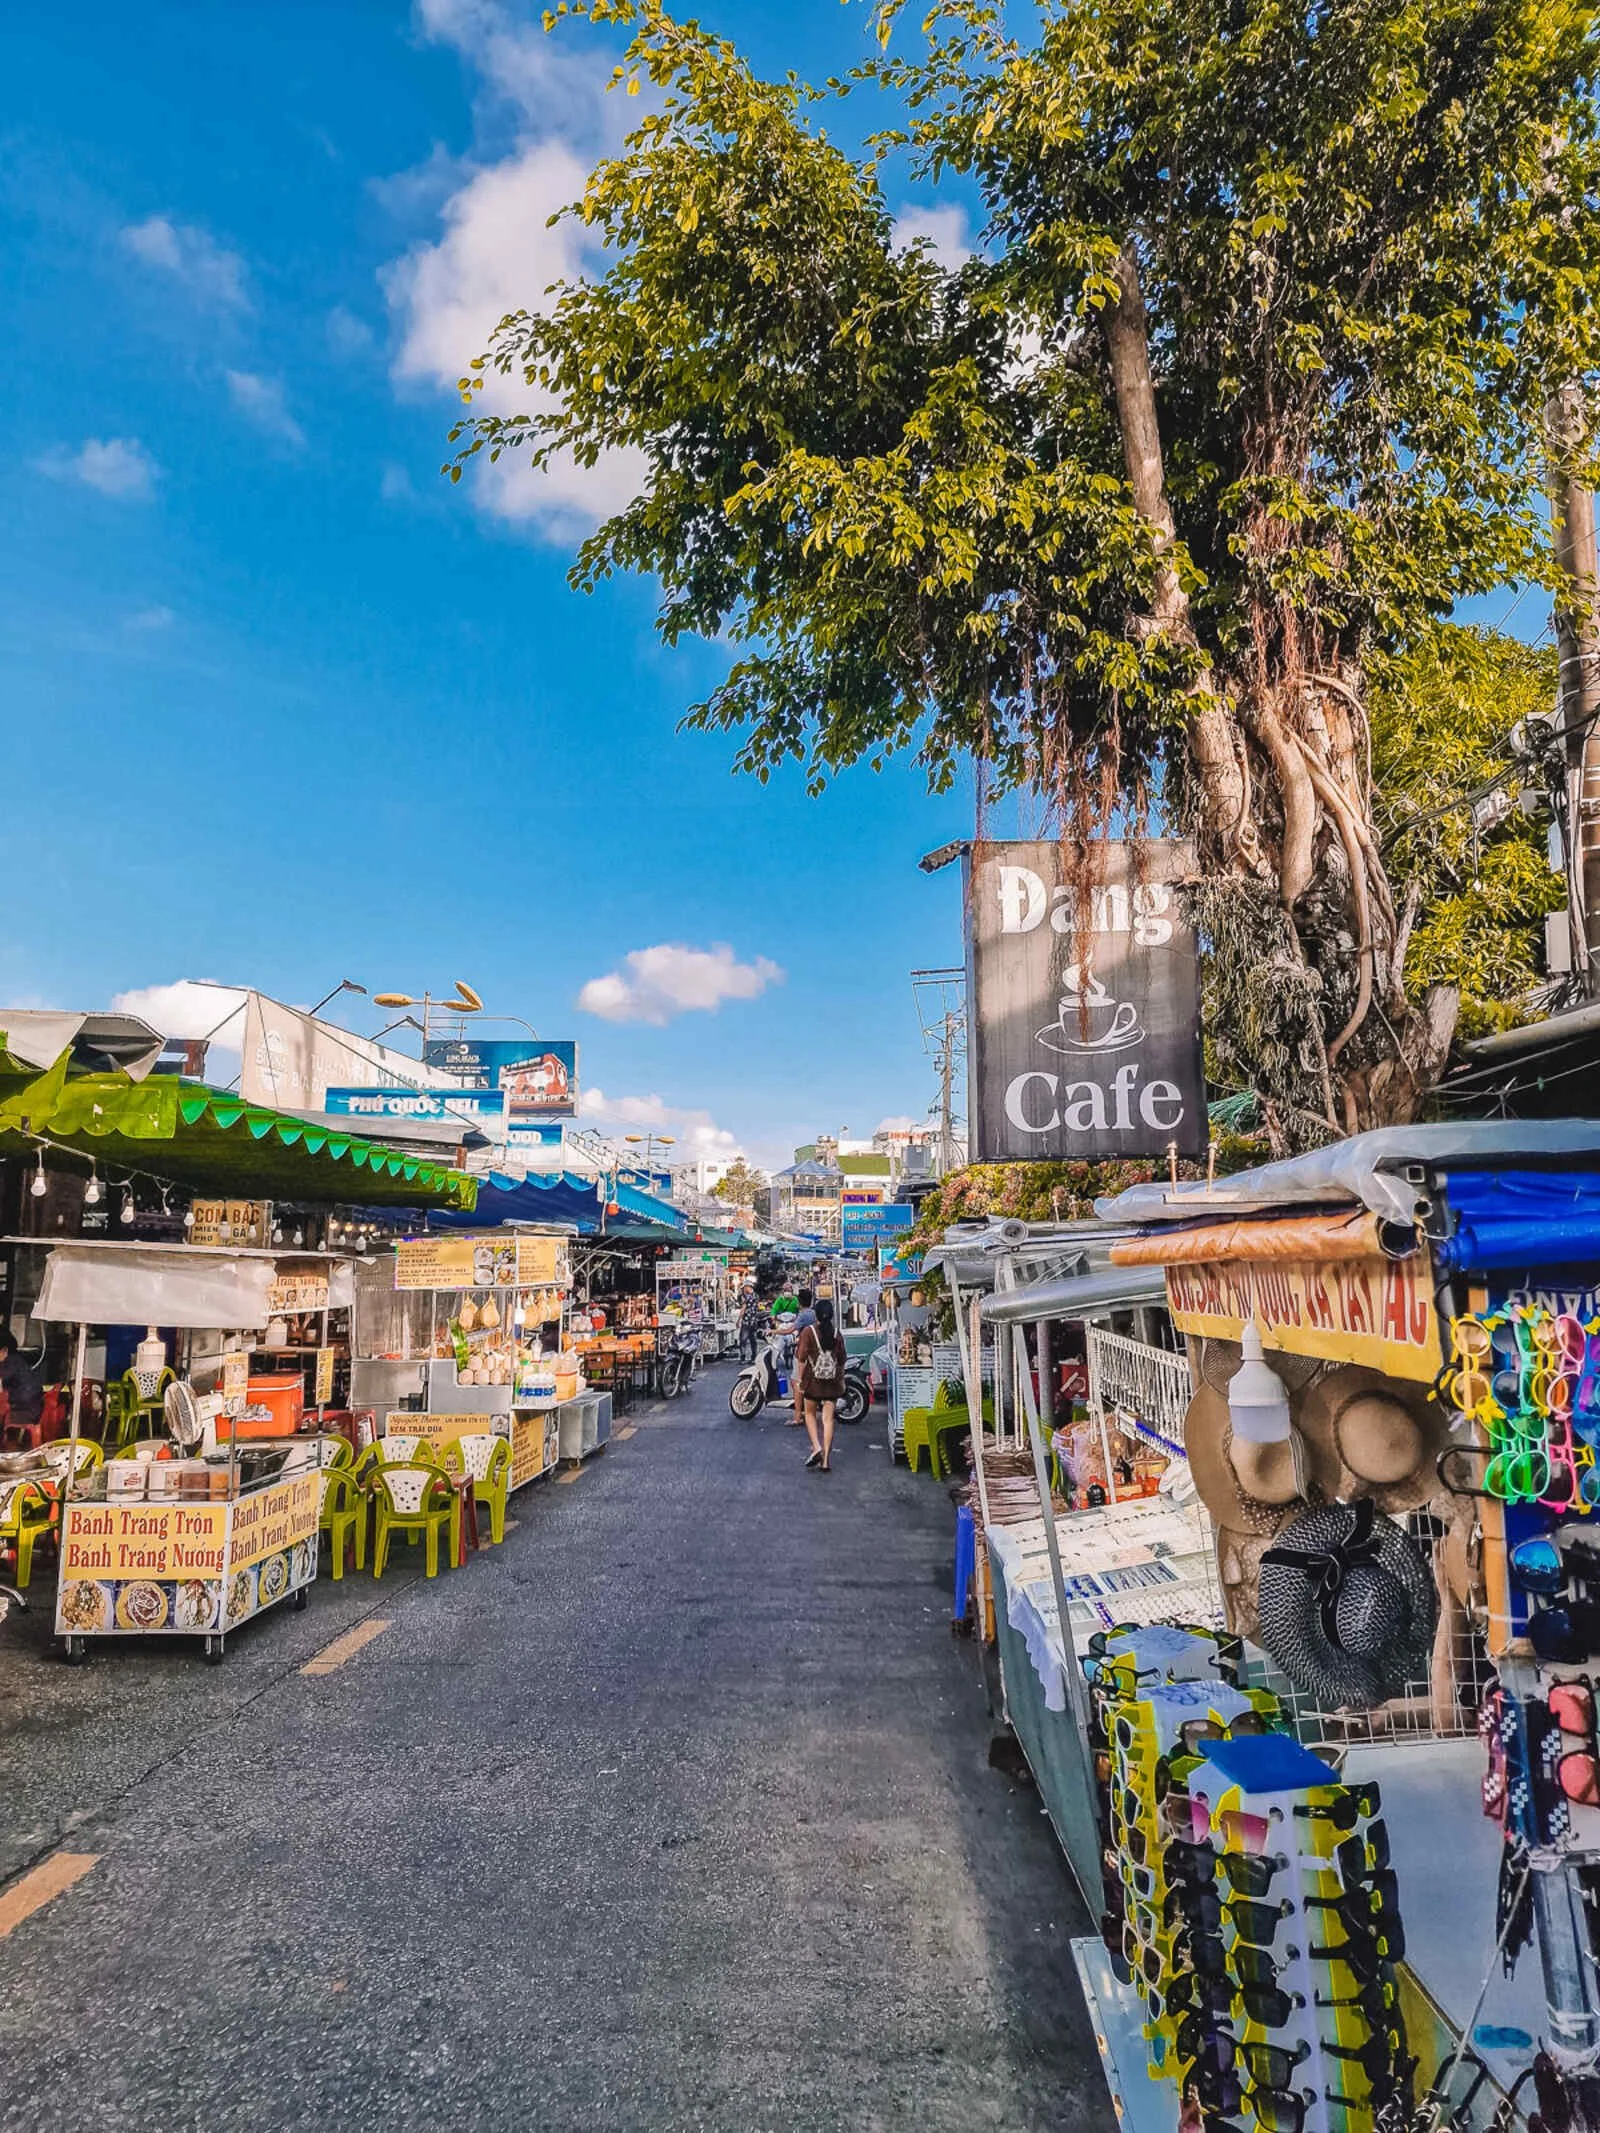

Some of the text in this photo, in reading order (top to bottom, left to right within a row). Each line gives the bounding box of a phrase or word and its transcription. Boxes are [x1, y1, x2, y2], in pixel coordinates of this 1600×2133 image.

[1003, 1064, 1185, 1133] Cafe
[70, 1510, 113, 1536] Bánh
[120, 1510, 169, 1540] Tráng
[68, 1542, 111, 1568] Bánh
[118, 1542, 167, 1573] Tráng
